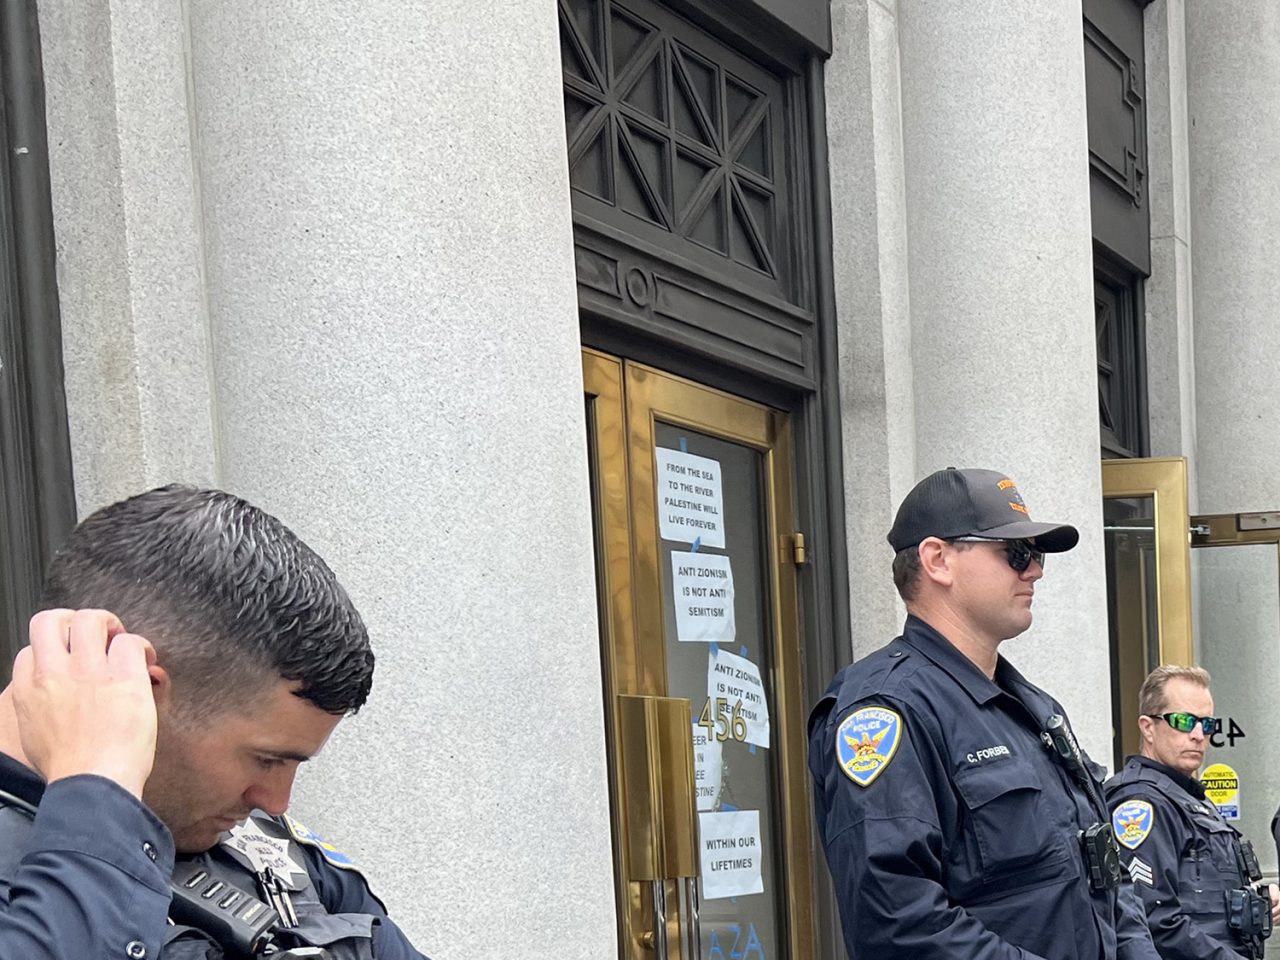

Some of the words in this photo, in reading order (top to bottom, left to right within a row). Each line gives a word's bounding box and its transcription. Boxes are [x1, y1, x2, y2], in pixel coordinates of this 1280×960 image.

[666, 463, 686, 475] FROM
[687, 467, 701, 478] THE
[701, 470, 714, 481] SEA
[668, 480, 679, 490] TO
[680, 483, 693, 493] THE
[694, 486, 714, 498] RIVER
[664, 496, 702, 512] PALESTINE
[703, 504, 719, 515] WILL
[668, 515, 685, 526] LIVE
[686, 517, 717, 531] FOREVER
[678, 566, 696, 577] ANTI
[697, 567, 728, 579] ZIONISM
[682, 587, 690, 597] IS
[691, 587, 707, 598] NOT
[709, 588, 726, 598] ANTI
[688, 607, 724, 618] SEMITISM
[714, 663, 734, 677] ANTI
[716, 682, 726, 693] IS
[727, 686, 744, 698] NOT
[745, 692, 762, 704] ANTI
[698, 696, 748, 742] 456
[853, 720, 881, 733] POLICE
[1201, 780, 1237, 789] CAUTION
[706, 837, 737, 851] WITHIN
[738, 836, 756, 849] OUR
[710, 858, 753, 871] LIFETIMES
